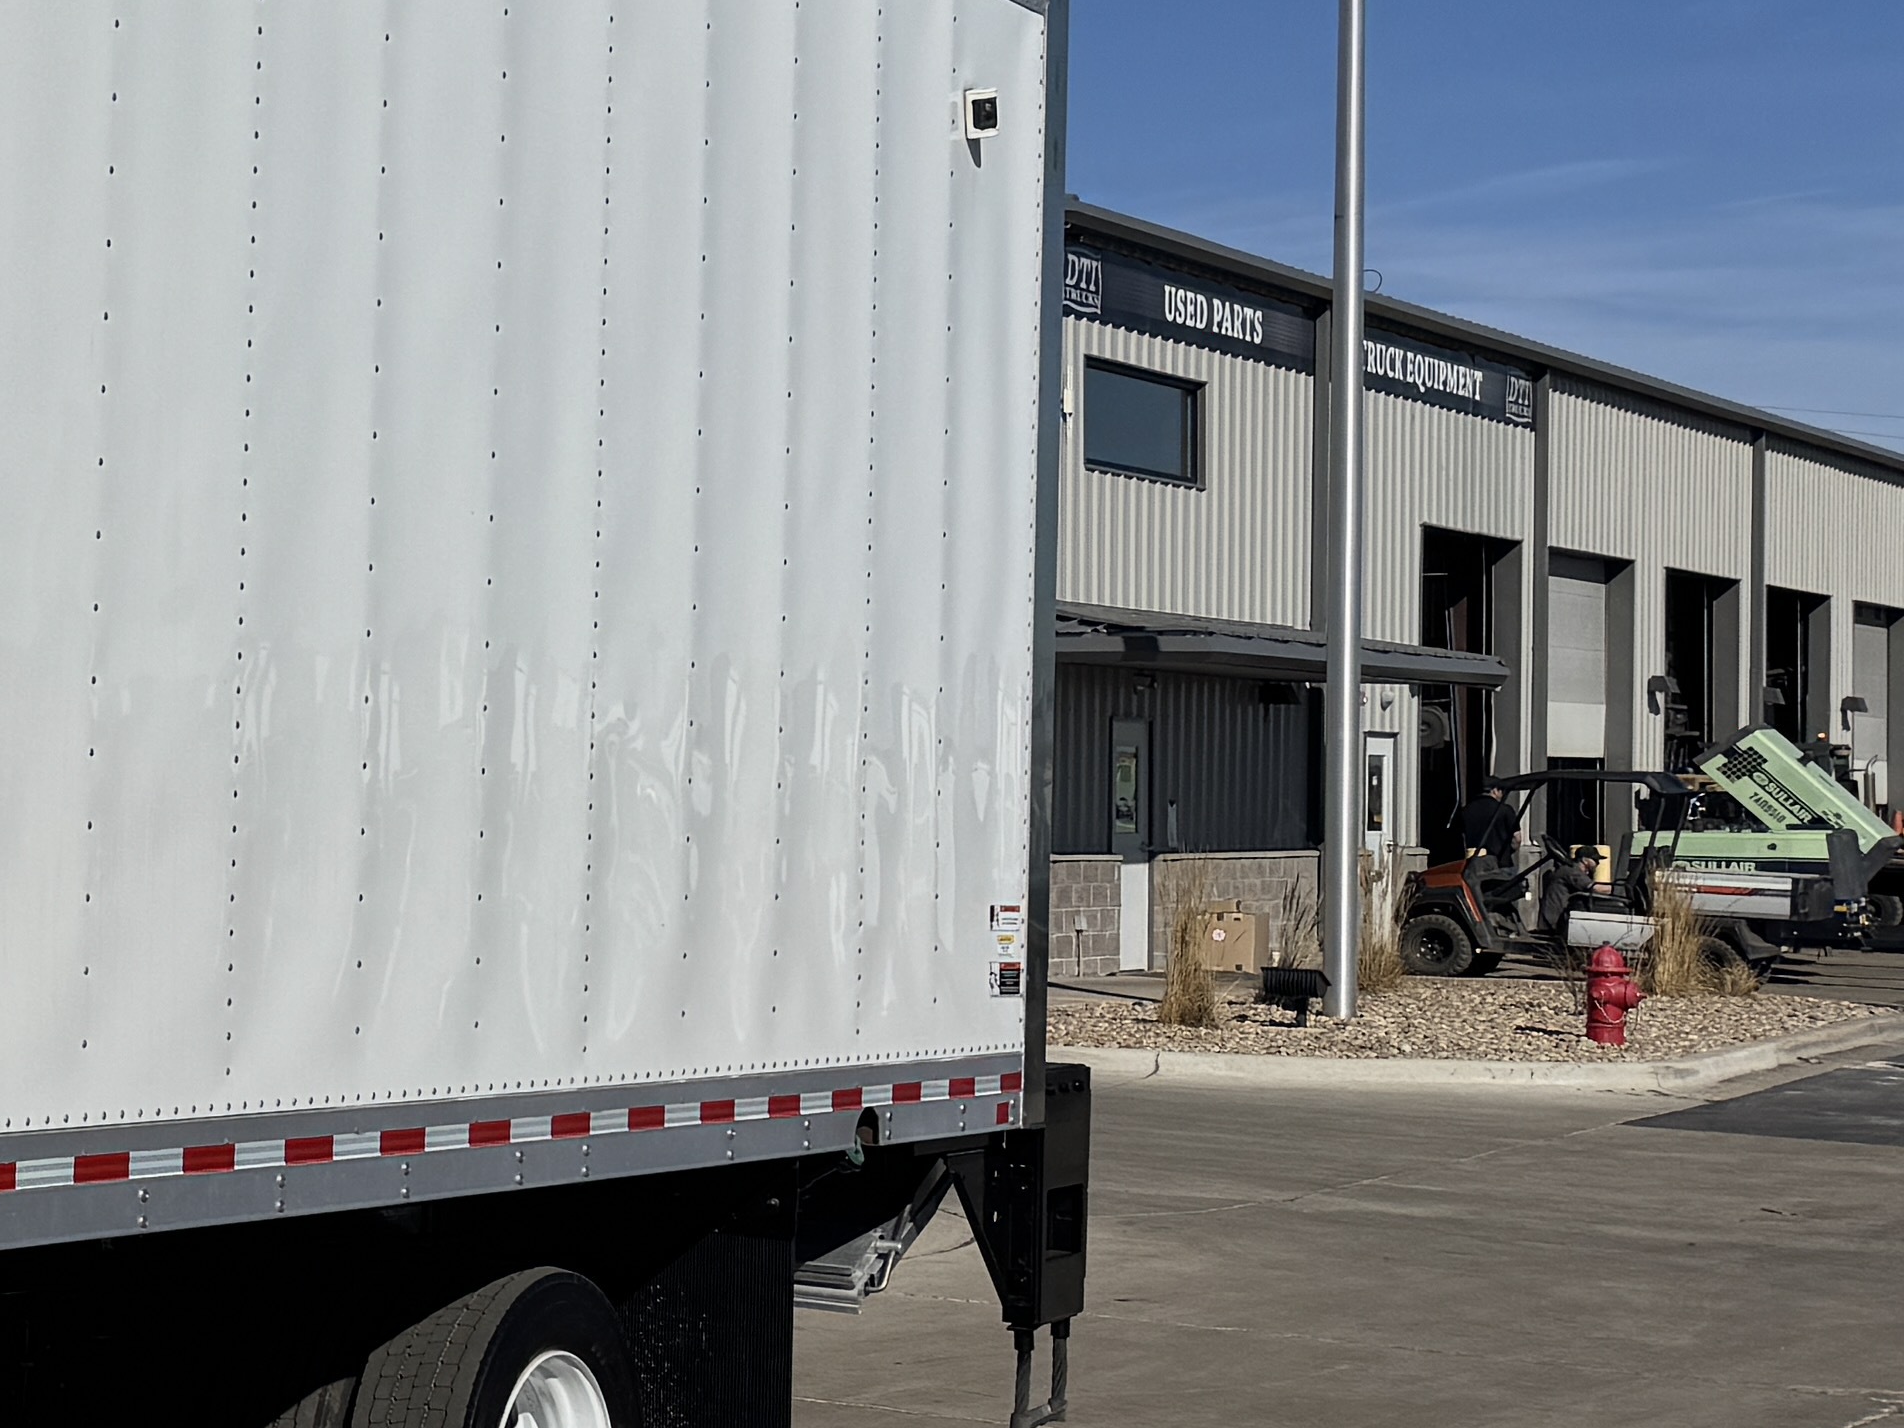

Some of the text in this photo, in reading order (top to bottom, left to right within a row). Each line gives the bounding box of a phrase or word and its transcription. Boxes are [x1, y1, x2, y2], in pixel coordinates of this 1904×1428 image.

[1065, 253, 1098, 292] DTI
[1163, 284, 1264, 345] USED PARTS
[1406, 351, 1483, 401] EQUIPMENT
[1764, 782, 1813, 824] SULLAIR
[1692, 861, 1756, 873] SULLAIR
